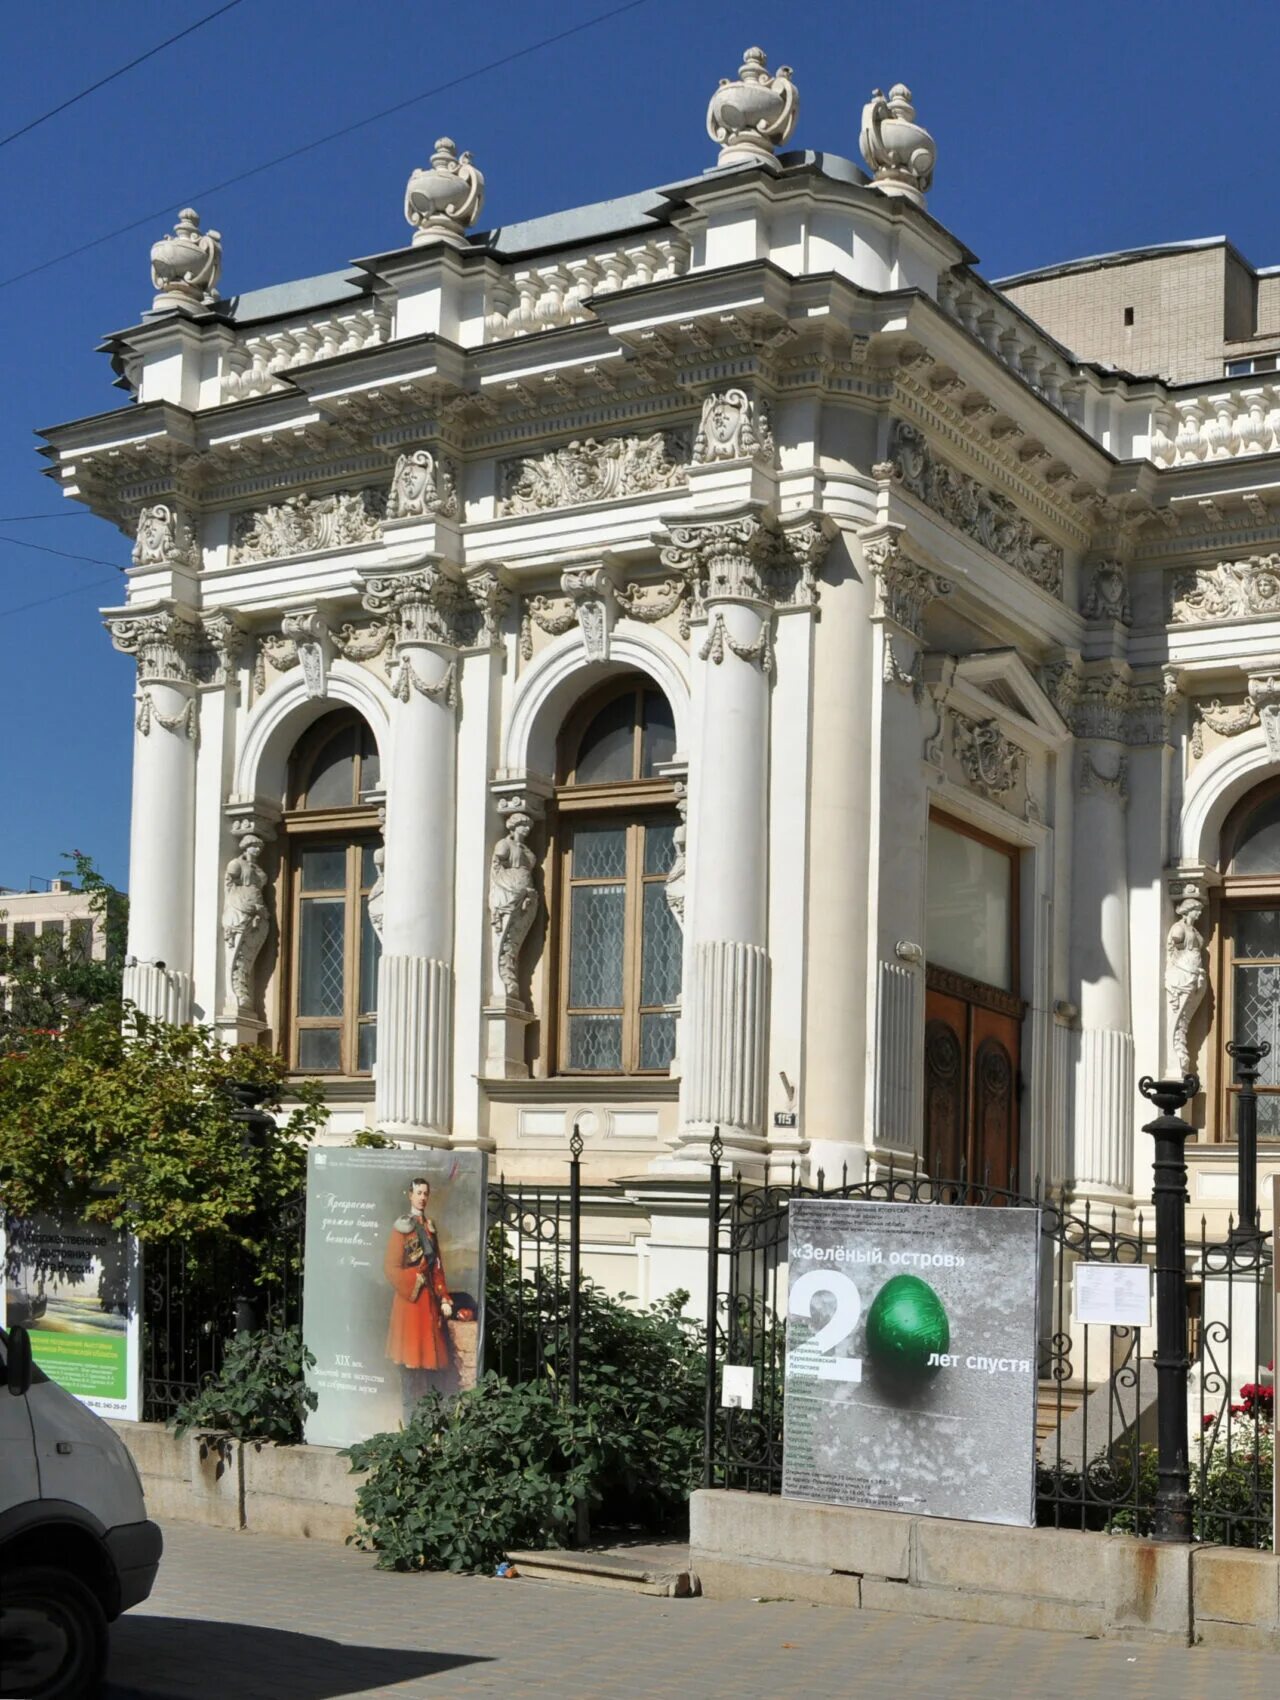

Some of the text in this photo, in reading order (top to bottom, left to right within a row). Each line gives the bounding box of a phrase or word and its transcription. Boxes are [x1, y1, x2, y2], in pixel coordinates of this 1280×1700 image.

[777, 1113, 792, 1125] 115
[792, 1243, 966, 1270] «Зелёный остров»
[927, 1352, 1031, 1374] лет спустя
